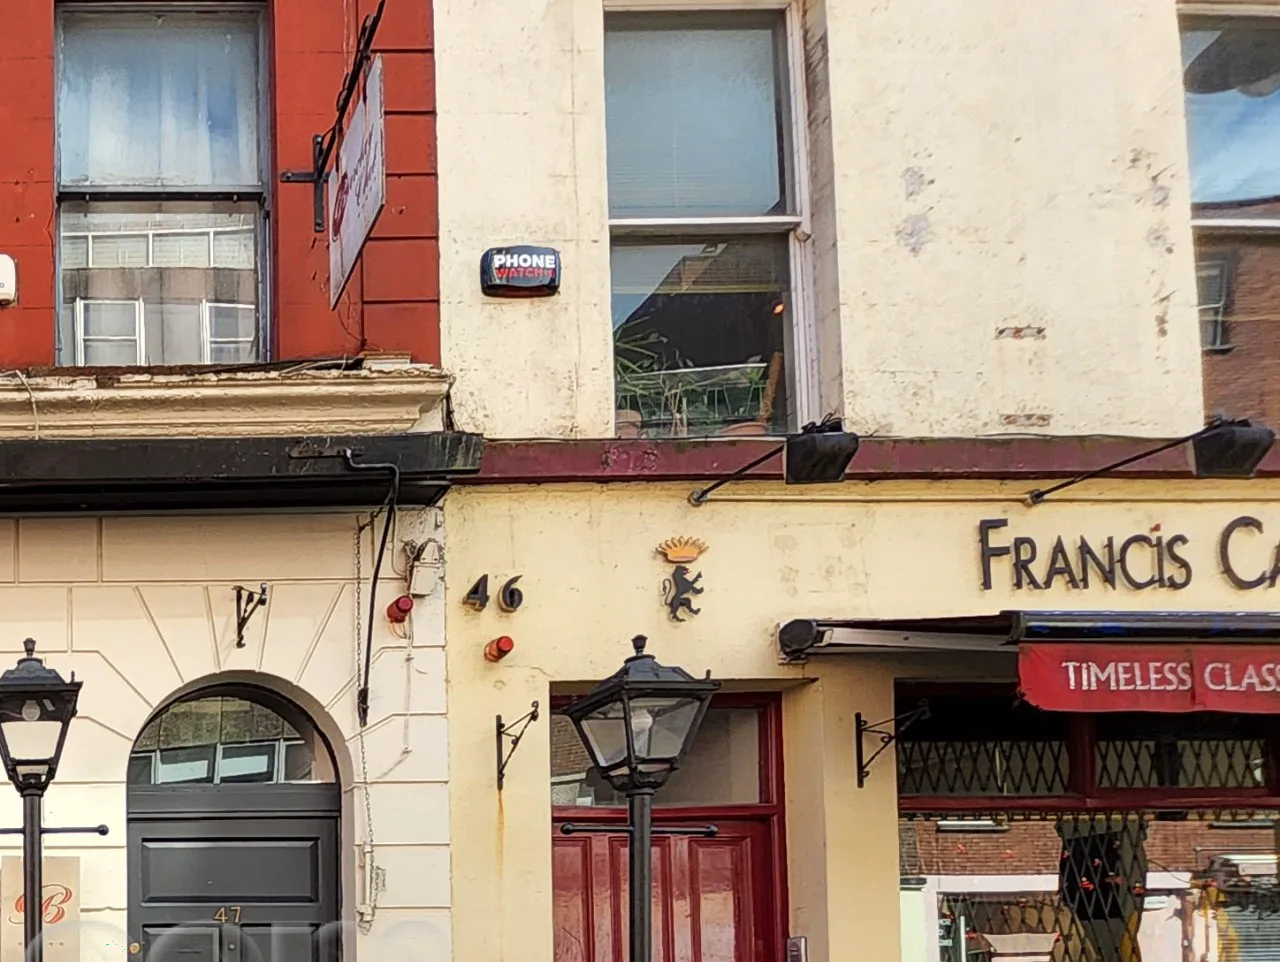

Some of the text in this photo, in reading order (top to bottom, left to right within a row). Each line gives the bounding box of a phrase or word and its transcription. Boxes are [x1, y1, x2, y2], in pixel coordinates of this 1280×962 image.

[494, 254, 556, 268] PHONE
[461, 573, 524, 613] 46
[1204, 662, 1280, 692] CLAS
[213, 906, 242, 924] 47
